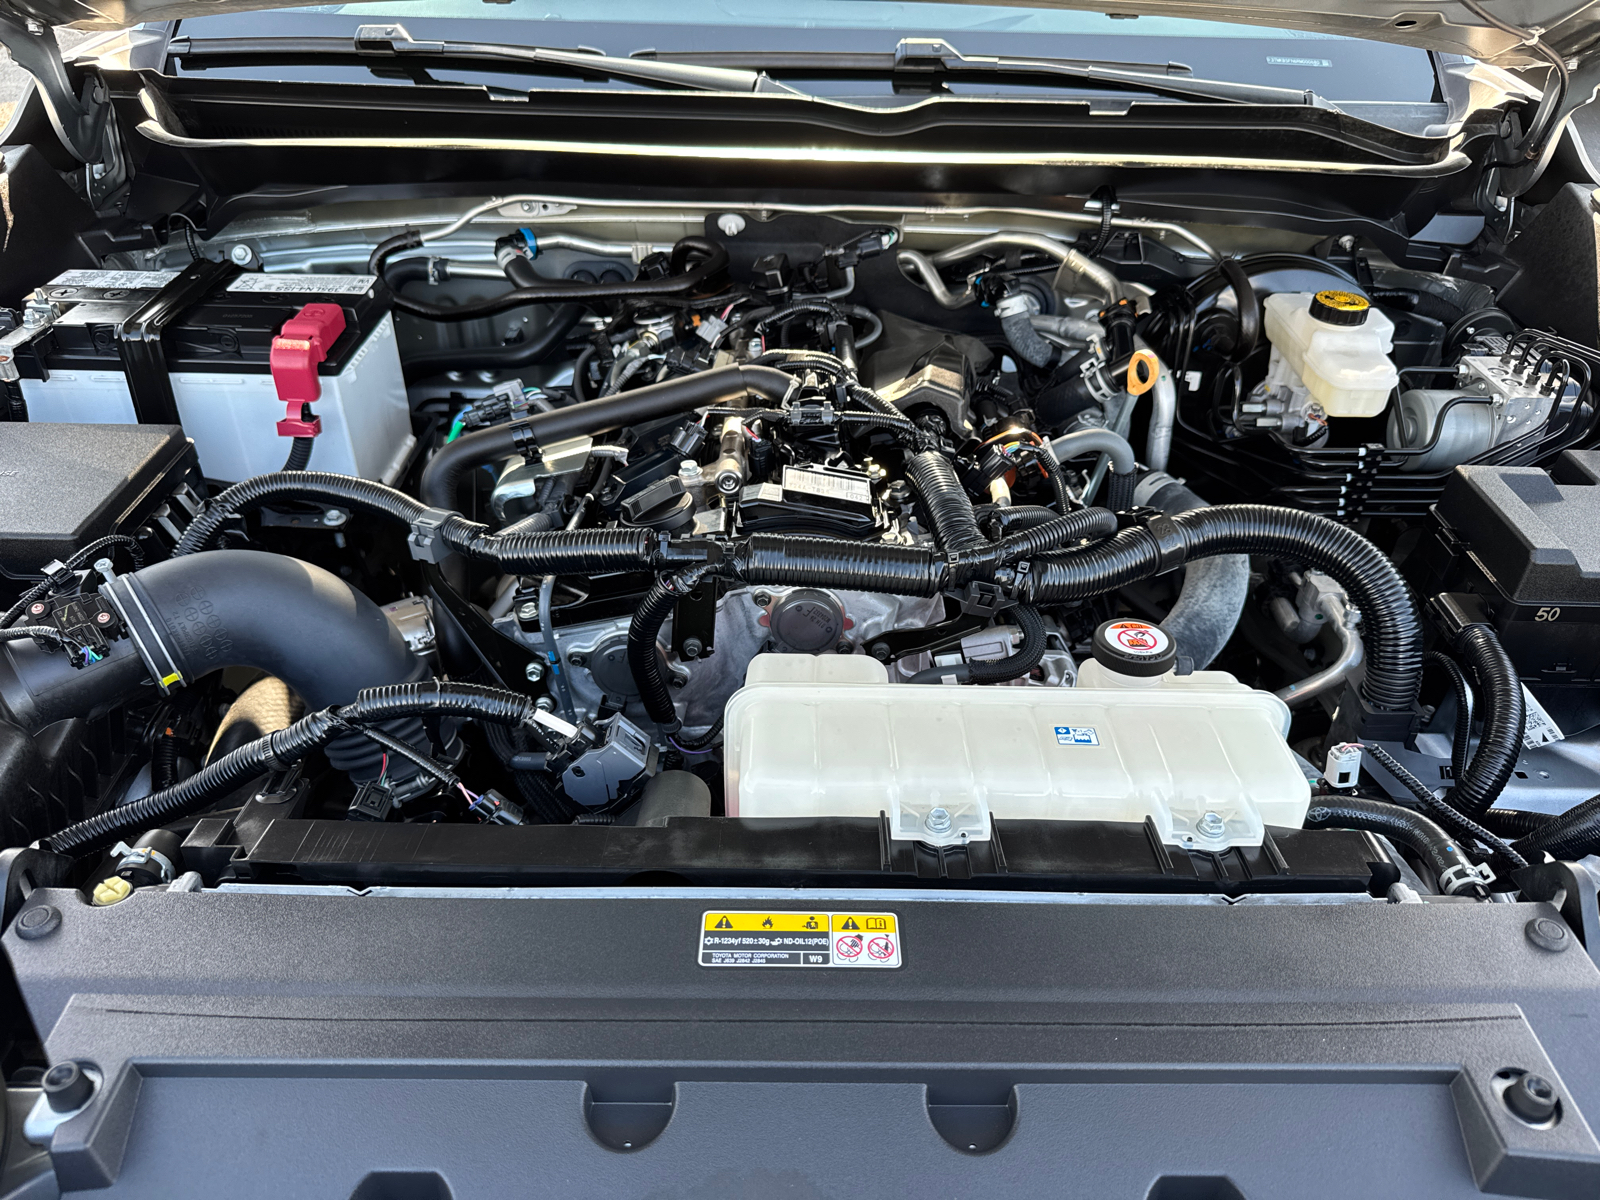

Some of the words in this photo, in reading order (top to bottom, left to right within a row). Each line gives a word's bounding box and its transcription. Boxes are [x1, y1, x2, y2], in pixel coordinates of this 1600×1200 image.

[1534, 607, 1561, 622] 50
[714, 937, 741, 946] R-1234yf
[742, 937, 770, 946] 520±30g
[784, 937, 829, 946] ND-OIL12(POE)
[809, 955, 823, 963] W9
